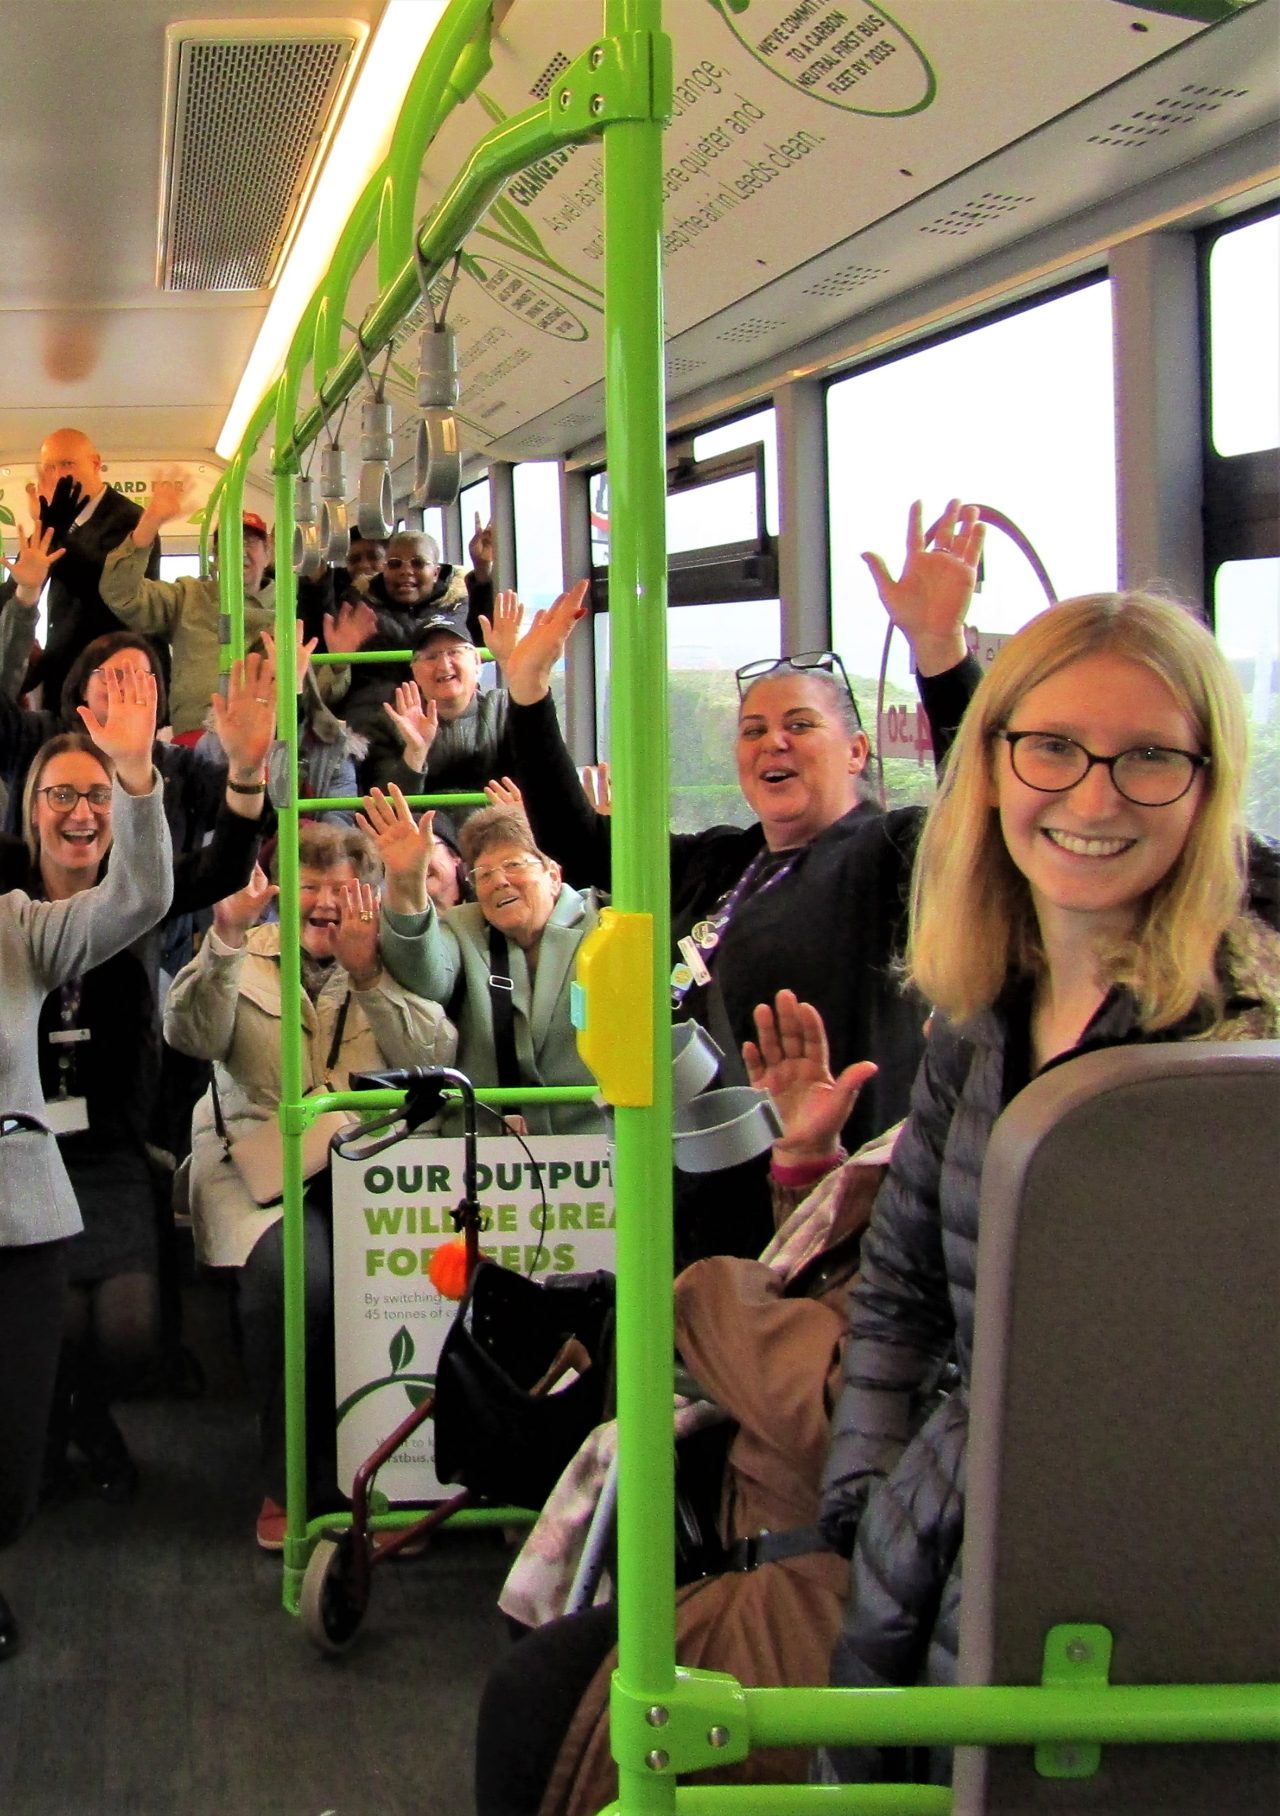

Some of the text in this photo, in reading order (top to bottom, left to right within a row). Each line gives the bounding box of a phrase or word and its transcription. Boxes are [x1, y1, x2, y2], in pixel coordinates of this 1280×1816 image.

[807, 10, 849, 48] CARBON
[796, 13, 886, 89] NEUTRAL FIRST BUS
[826, 40, 897, 96] FLEET BY 2035
[679, 125, 735, 178] quieter
[724, 92, 766, 135] and
[508, 158, 560, 207] CHANGE
[718, 160, 780, 200] Leeds
[363, 1160, 615, 1194] OUR OUTPUT
[481, 1243, 576, 1273] EEDS
[384, 1309, 427, 1320] tonnes
